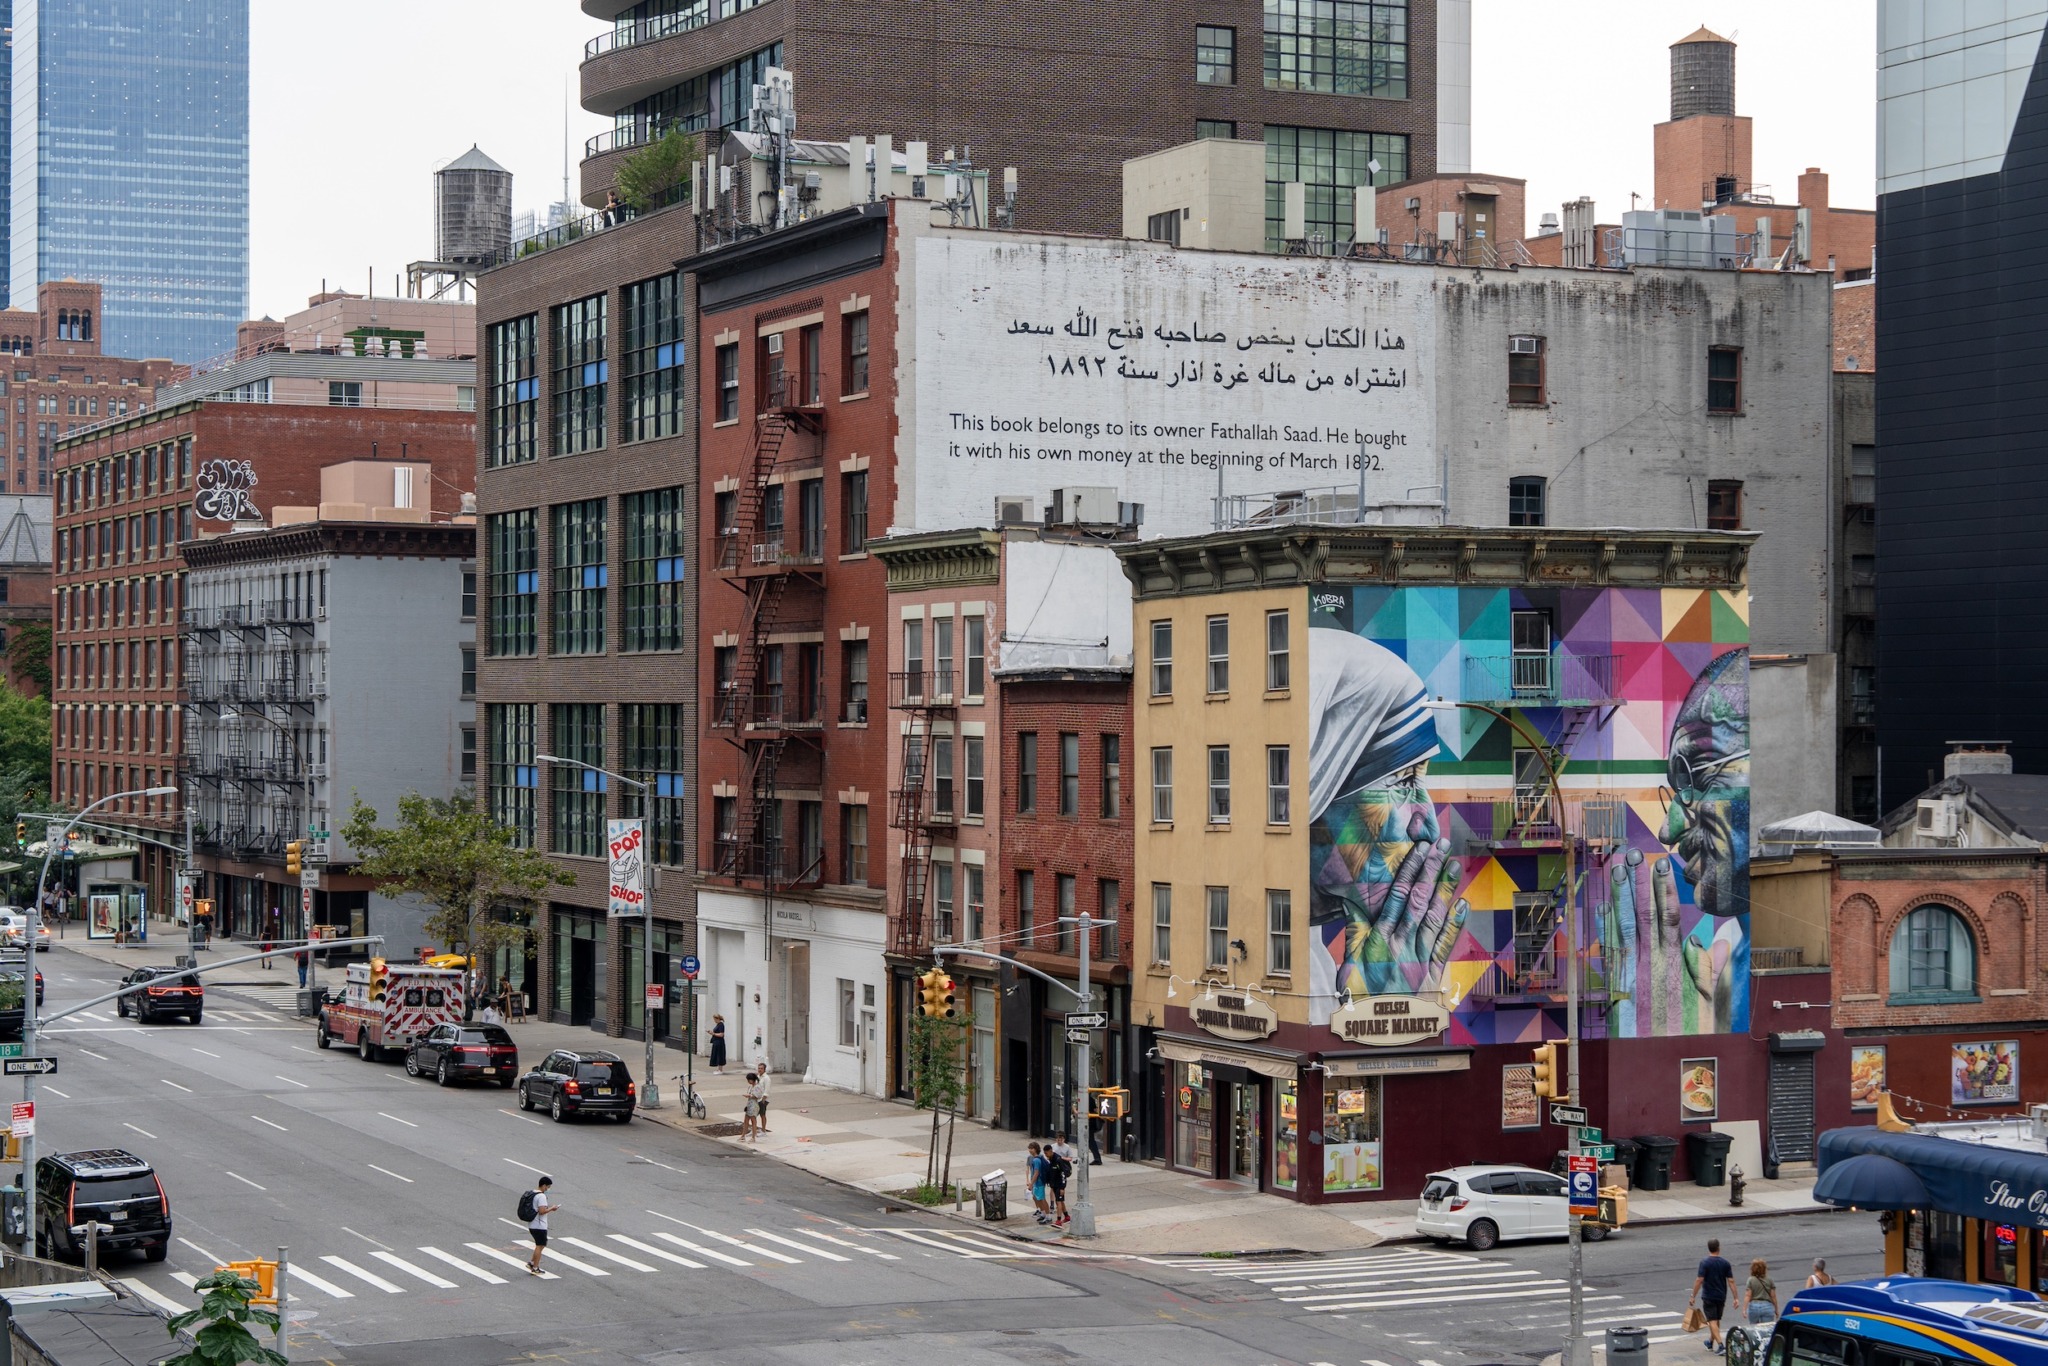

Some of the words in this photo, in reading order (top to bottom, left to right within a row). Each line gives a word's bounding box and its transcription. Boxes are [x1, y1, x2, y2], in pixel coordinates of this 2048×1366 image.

[1007, 319, 1054, 335] سعد
[1107, 319, 1144, 349] فتح
[1154, 320, 1226, 347] صاحبه
[1236, 327, 1296, 353] يخص
[1305, 326, 1366, 356] الكتاب
[1375, 328, 1405, 351] هذا
[1117, 355, 1158, 379] سنة
[1166, 359, 1203, 387] اذار
[1213, 362, 1249, 390] غرة
[1305, 368, 1334, 391] من
[1344, 367, 1406, 393] اشتراه
[949, 413, 984, 431] This
[991, 415, 1033, 433] book
[1039, 417, 1100, 439] belongs
[1106, 421, 1123, 435] to
[1129, 421, 1147, 436] its
[1153, 425, 1205, 438] owner
[1211, 422, 1278, 441] Fathallah
[1283, 426, 1322, 443] Saad.
[1327, 428, 1349, 443] He
[1355, 429, 1407, 450] bought
[949, 442, 960, 457] it
[966, 442, 1002, 459] with
[1009, 443, 1030, 460] his
[1037, 449, 1072, 461] own
[1078, 449, 1133, 467] money
[1138, 450, 1153, 463] at
[1159, 448, 1184, 465] the
[1191, 449, 1263, 471] beginning
[1269, 452, 1284, 468] of
[1290, 452, 1337, 469] March
[1346, 454, 1384, 471] 1892.
[1313, 594, 1345, 606] KOBRA
[610, 829, 642, 859] POP
[610, 885, 643, 904] SHOP
[1217, 995, 1246, 1011] CHELSEA
[1374, 1001, 1410, 1015] CHELSEA
[1196, 1008, 1229, 1028] SQUARE
[1230, 1013, 1268, 1034] MARKET
[1345, 1019, 1389, 1038] SQUARE
[1392, 1017, 1439, 1035] MARKET
[1, 1046, 11, 1056] 18
[11, 1062, 27, 1071] ONE
[33, 1062, 50, 1070] WAY
[1357, 1061, 1385, 1070] CHELSEA
[1387, 1060, 1411, 1069] SQUARE
[1412, 1058, 1438, 1067] MARKET
[1984, 1085, 2015, 1096] GROCERIES
[1556, 1111, 1566, 1119] ONE
[1570, 1113, 1582, 1121] WAY
[1582, 1128, 1589, 1139] 10
[1594, 1148, 1602, 1158] 18
[1984, 1180, 2025, 1209] Star
[1995, 1226, 2017, 1240] OPEN
[1844, 1318, 1860, 1330] 5521
